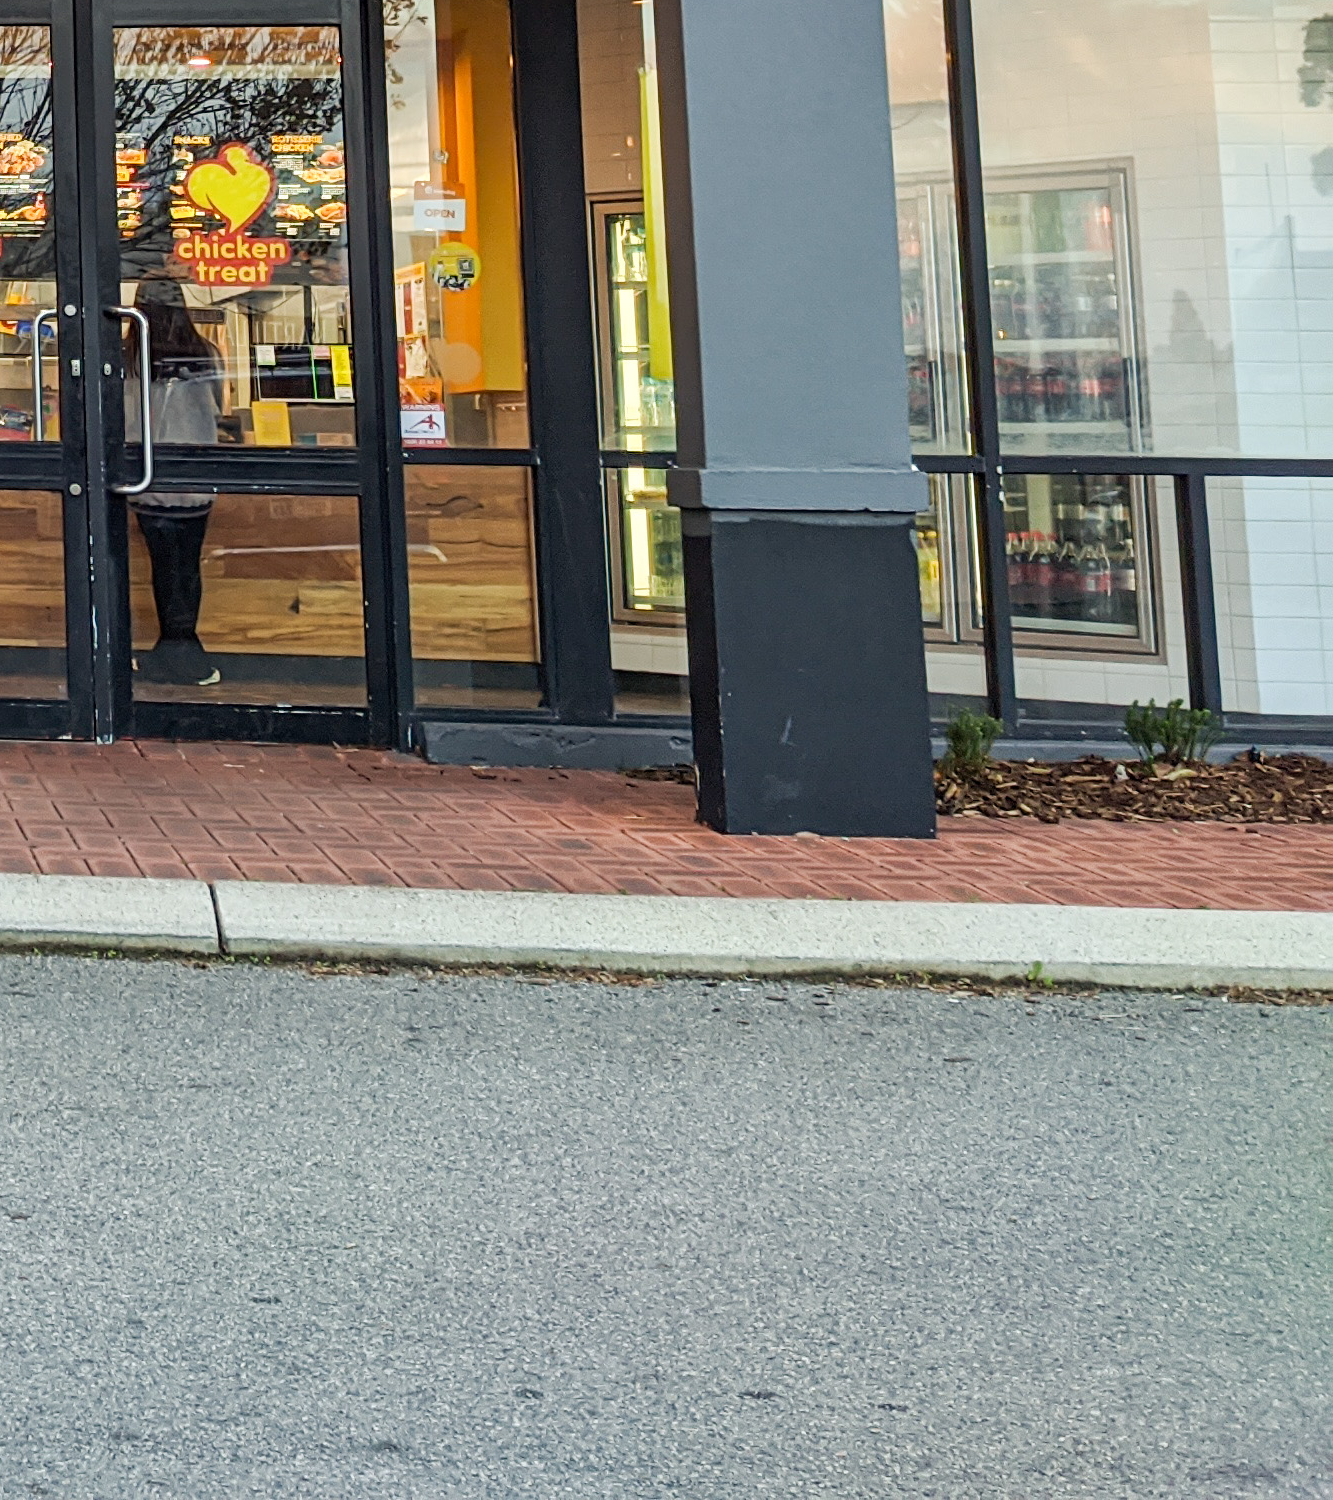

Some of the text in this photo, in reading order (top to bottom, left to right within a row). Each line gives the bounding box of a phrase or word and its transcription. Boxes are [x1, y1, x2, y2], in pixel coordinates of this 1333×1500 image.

[271, 143, 314, 152] CHICKEN
[424, 208, 456, 219] OPEN
[177, 234, 286, 259] chicken
[195, 260, 269, 283] treat
